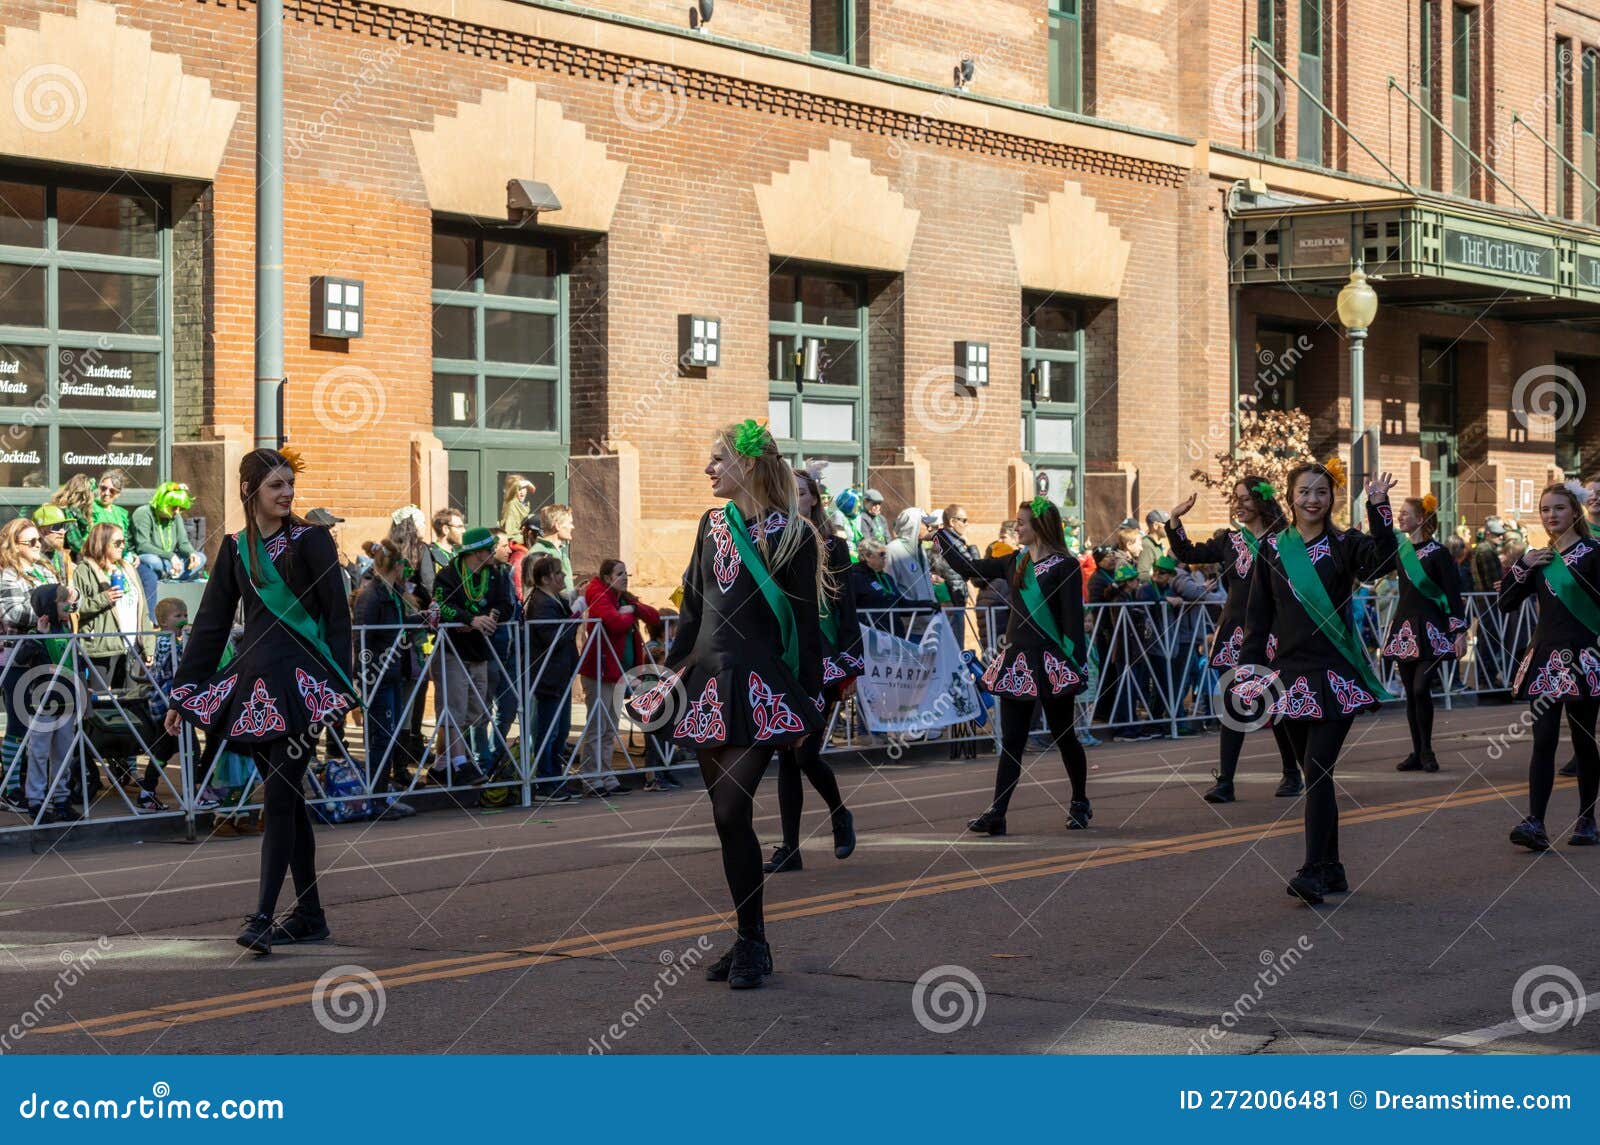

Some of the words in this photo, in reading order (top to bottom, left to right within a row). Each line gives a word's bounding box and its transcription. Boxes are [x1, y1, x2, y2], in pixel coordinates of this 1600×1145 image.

[1460, 236, 1484, 266] THE
[1485, 240, 1503, 269] ICE
[1505, 243, 1540, 275] HOUSE
[86, 365, 132, 379] Authentic
[0, 380, 28, 394] Meats
[60, 382, 104, 396] Brazilian
[106, 384, 157, 399] Steakhouse
[63, 451, 107, 465] Gourmet
[107, 452, 134, 466] Salad
[135, 453, 154, 466] Bar
